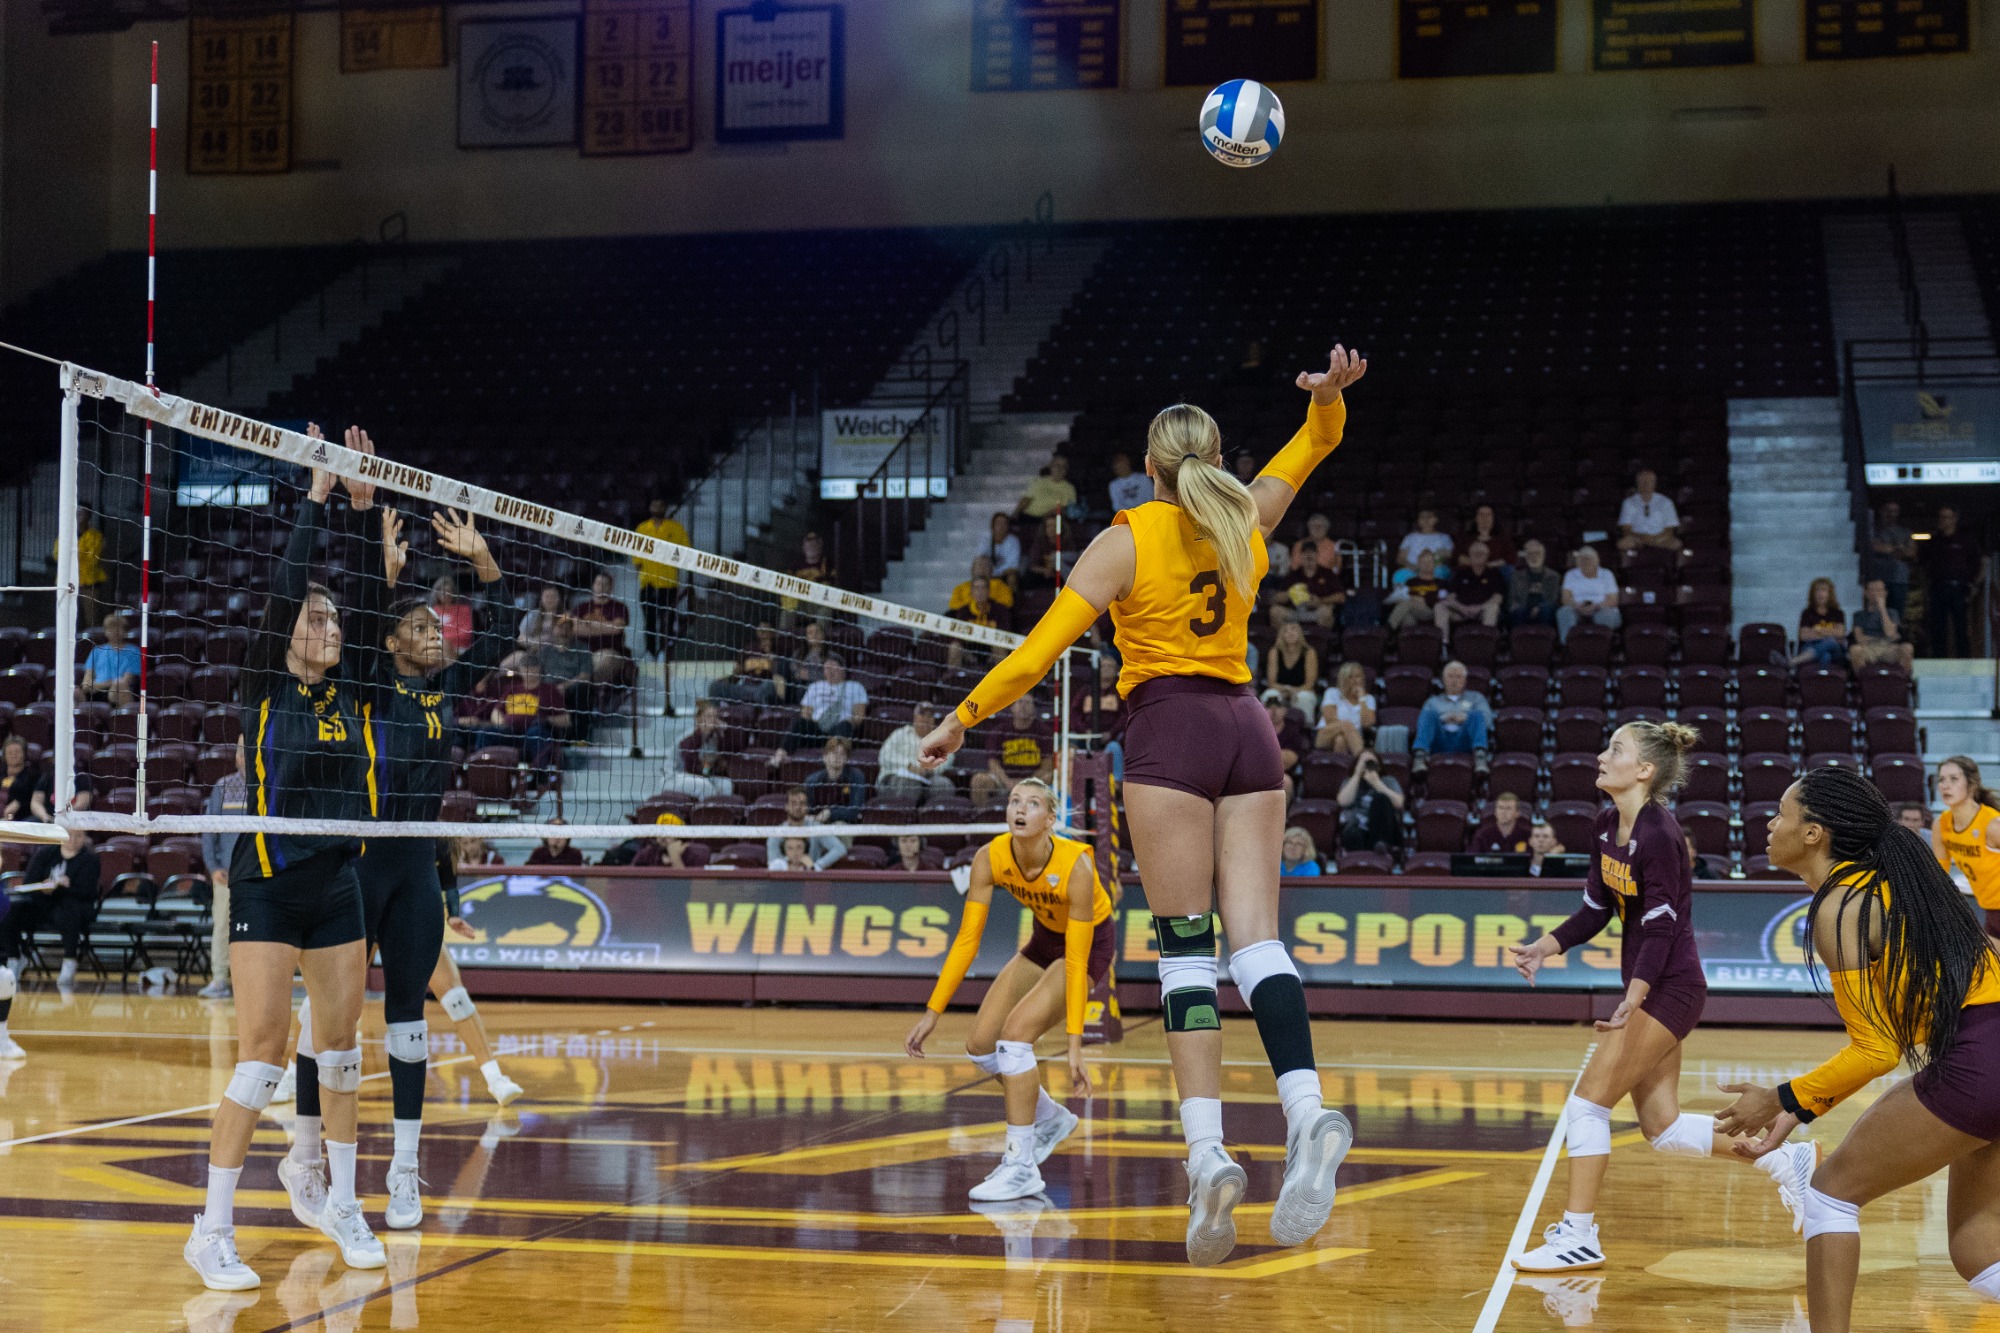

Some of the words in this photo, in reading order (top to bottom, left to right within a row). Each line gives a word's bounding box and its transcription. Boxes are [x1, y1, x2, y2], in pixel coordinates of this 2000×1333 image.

[728, 51, 826, 90] meijer
[1213, 134, 1260, 155] molten
[190, 404, 282, 450] CHIPPEWAS
[358, 455, 433, 492] CHIPPEWAS
[494, 495, 555, 527] CHIPPEWAS
[1189, 568, 1229, 639] 3
[425, 711, 442, 740] 11
[686, 901, 952, 958] WINGS
[499, 947, 561, 962] WILD
[567, 949, 645, 964] WINGS
